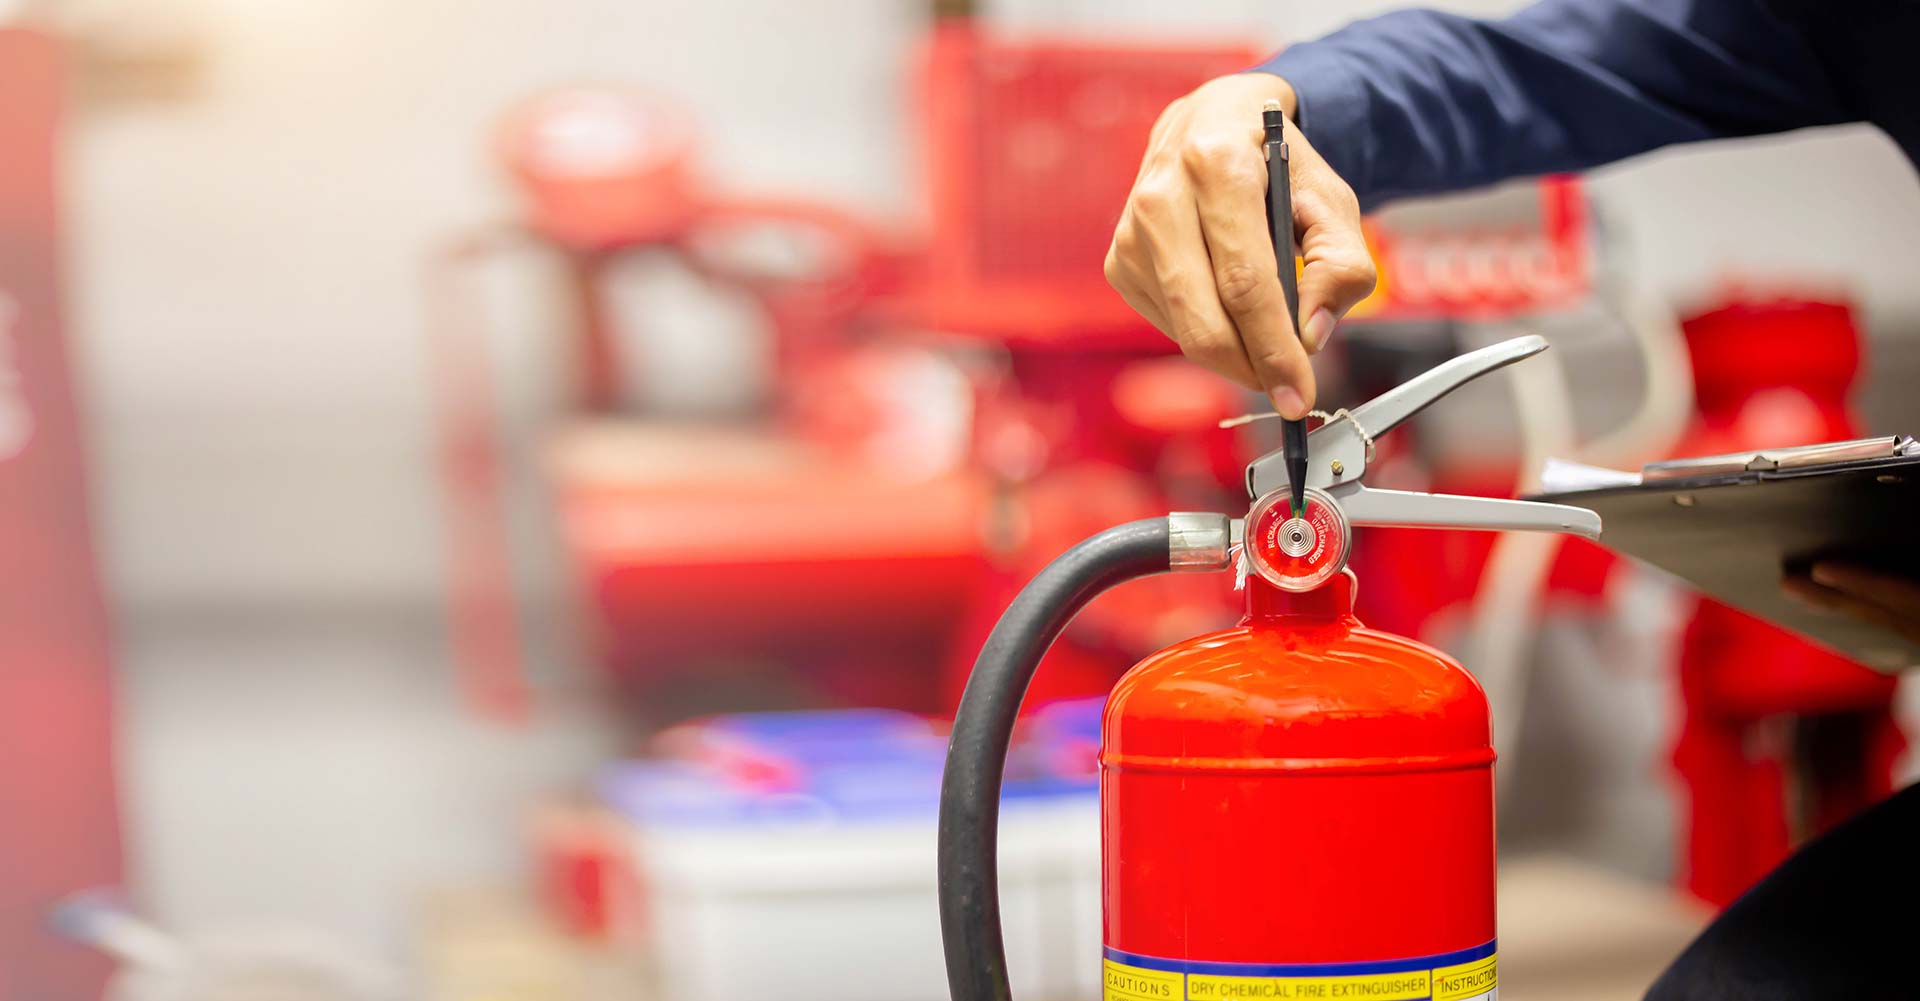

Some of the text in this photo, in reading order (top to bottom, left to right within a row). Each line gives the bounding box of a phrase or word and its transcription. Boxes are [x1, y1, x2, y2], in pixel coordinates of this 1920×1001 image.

[1267, 514, 1285, 549] RECHARGE
[1309, 518, 1326, 565] OVERCHARGED
[1107, 972, 1170, 997] CAUTIONS
[1191, 978, 1426, 998] DRY CHEMICAL FIRE EXTINGUISHER
